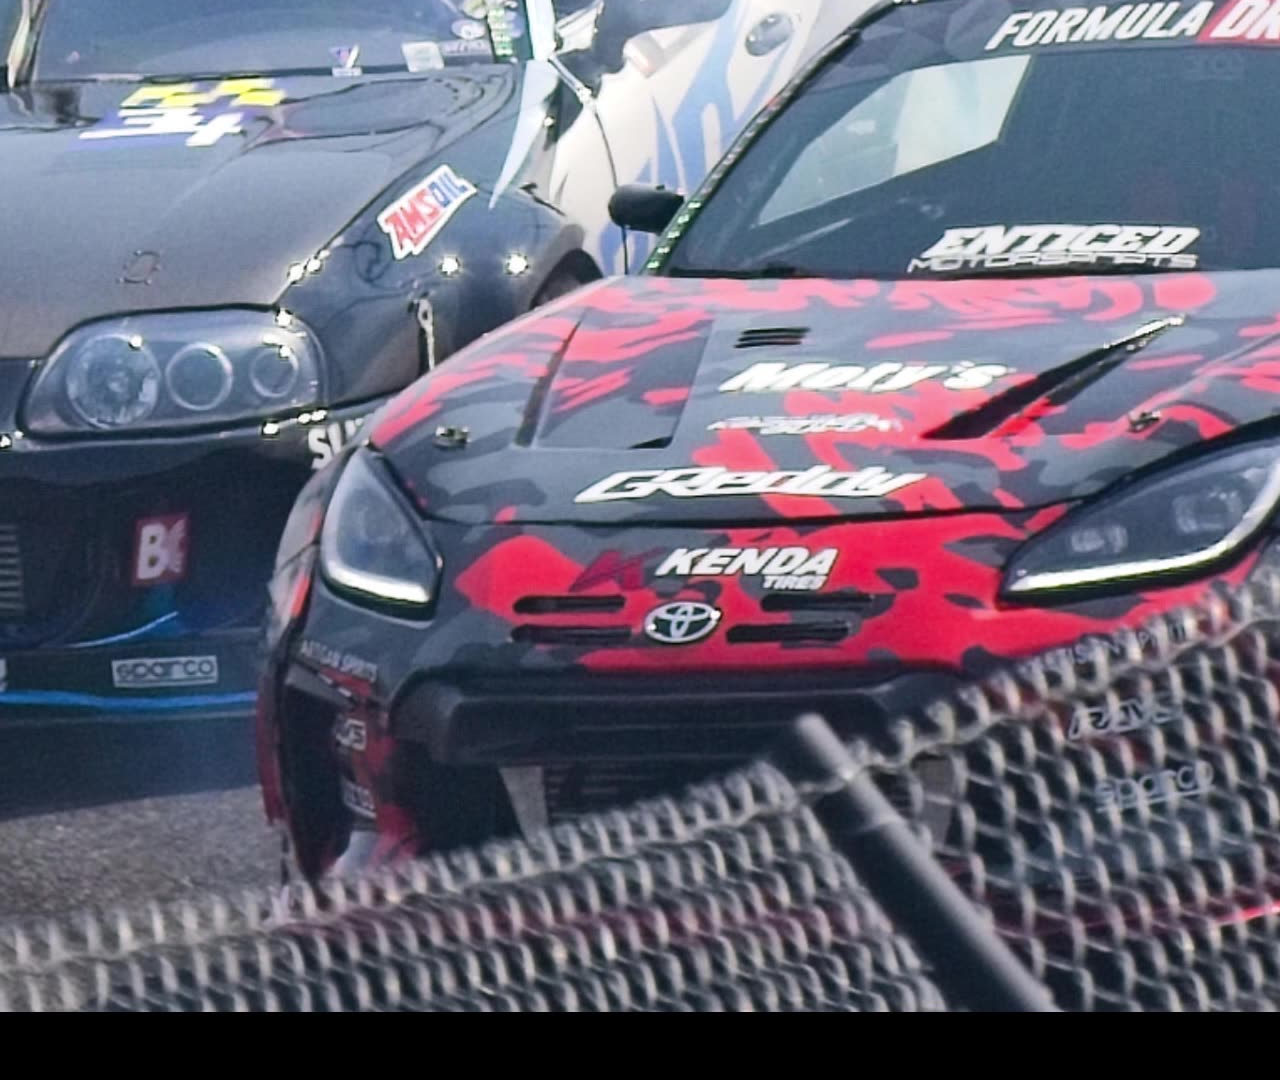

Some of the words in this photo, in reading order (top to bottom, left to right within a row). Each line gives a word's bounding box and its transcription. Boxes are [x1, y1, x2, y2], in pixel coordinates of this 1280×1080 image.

[984, 0, 1215, 50] FORMULA
[382, 165, 470, 255] AMSOIL
[921, 223, 1201, 259] ENTICED
[719, 361, 1010, 394] Moty's
[573, 464, 927, 504] GReddy
[654, 547, 839, 576] KENDA
[762, 575, 827, 590] TIRES
[115, 660, 217, 683] sparco
